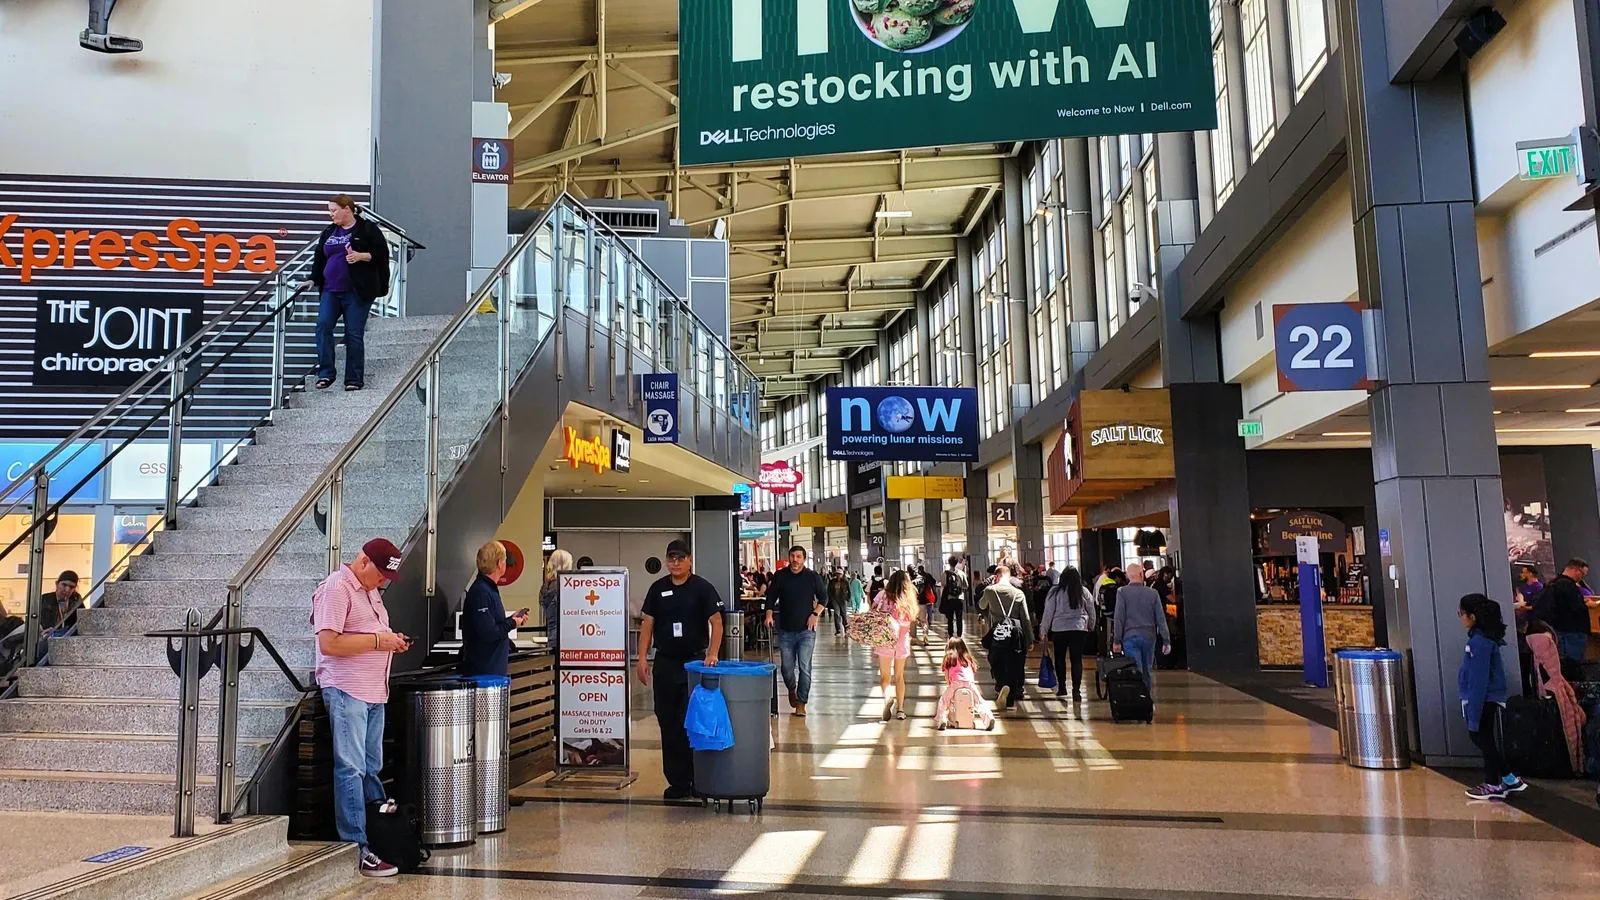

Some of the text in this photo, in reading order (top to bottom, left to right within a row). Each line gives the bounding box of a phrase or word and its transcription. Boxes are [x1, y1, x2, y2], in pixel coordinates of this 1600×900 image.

[732, 41, 1157, 112] restocking with AI
[1057, 107, 1100, 118] Welcome
[1102, 106, 1112, 115] to
[1114, 104, 1135, 114] Now
[1151, 101, 1192, 112] Dell.com
[700, 122, 836, 146] DELL Technologies
[1527, 147, 1570, 176] EXIT
[472, 172, 509, 181] ELEVATOR
[46, 300, 90, 324] THE
[83, 306, 191, 350] JOINT
[1289, 324, 1354, 369] 22
[41, 352, 188, 375] chiropraci
[650, 381, 670, 390] CHAIR
[645, 391, 675, 400] MASSAGE
[1241, 423, 1259, 435] EXIT
[842, 433, 963, 445] powering lunar missions
[1091, 425, 1164, 447] SALT LICK
[564, 425, 611, 475] XpresSpa
[139, 462, 183, 474] ess
[996, 508, 1012, 521] 21
[121, 515, 146, 527] Calm
[1289, 518, 1323, 526] SALT LICK
[872, 536, 883, 544] 20
[1310, 531, 1333, 540] Wine
[563, 577, 620, 589] XpresSpa
[560, 651, 583, 660] Relief
[583, 651, 599, 660] and
[562, 671, 624, 686] XpresSpa
[579, 692, 607, 702] OPEN
